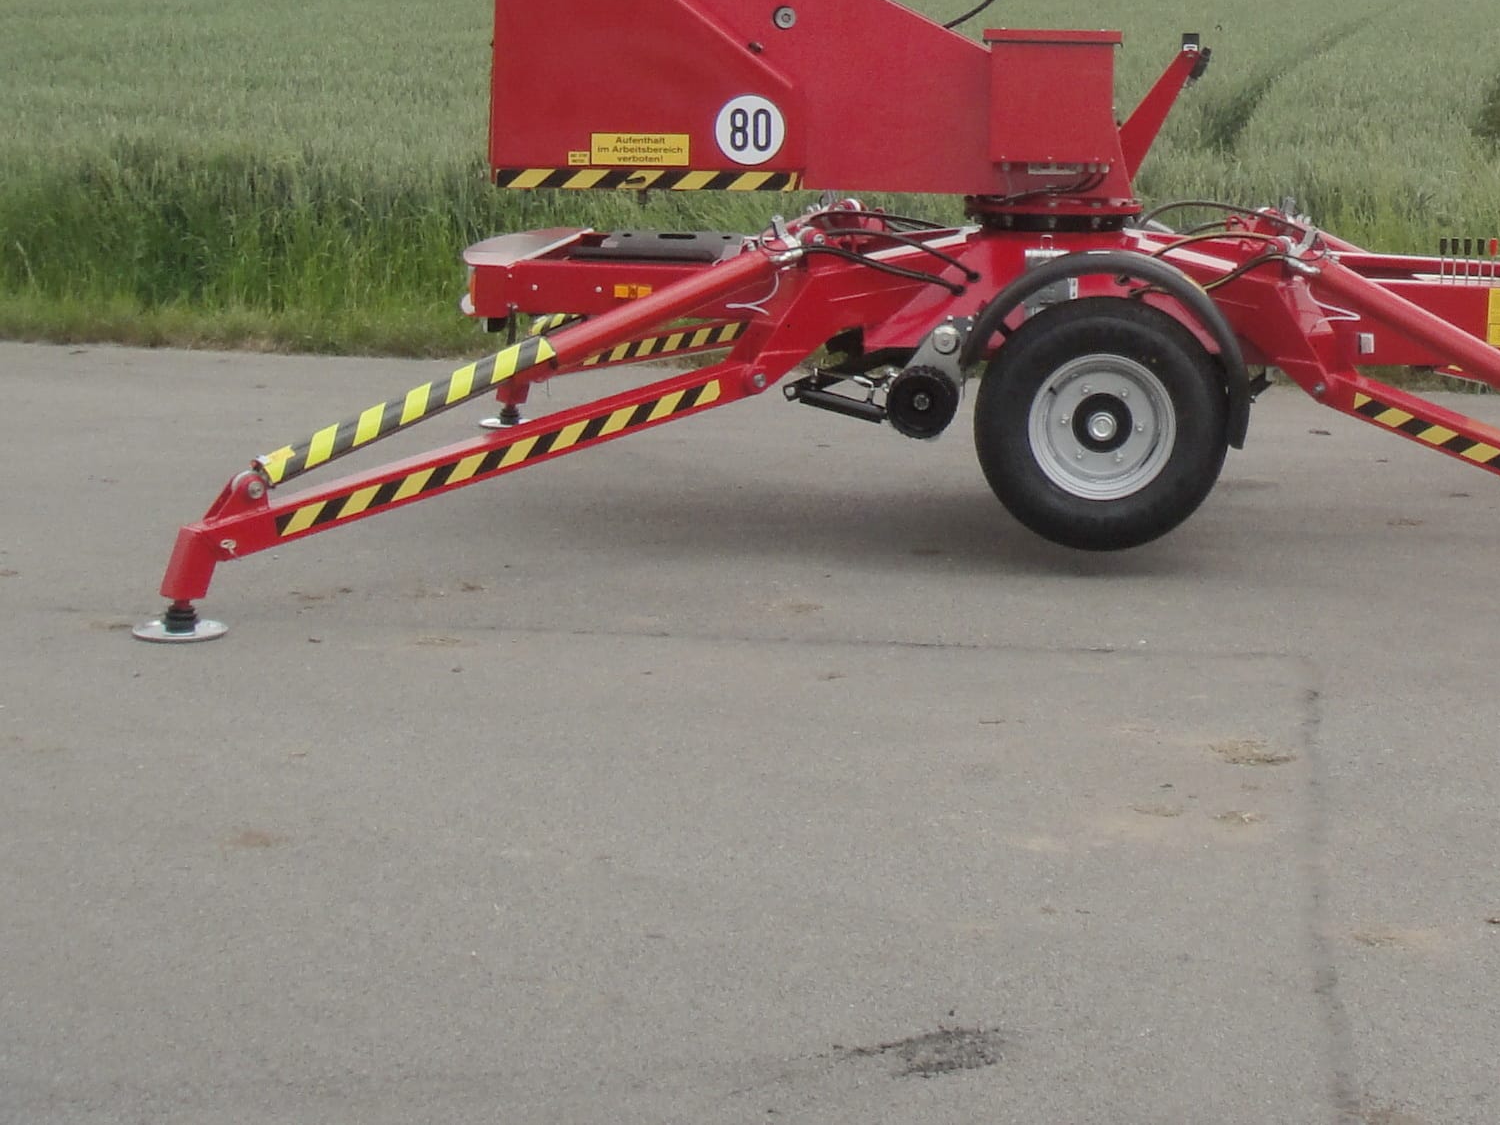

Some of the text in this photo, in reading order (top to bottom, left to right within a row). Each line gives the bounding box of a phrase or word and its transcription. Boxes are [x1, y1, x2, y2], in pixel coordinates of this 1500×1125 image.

[730, 108, 772, 152] 80
[615, 136, 665, 145] Aufenthalt
[597, 145, 684, 154] im Arbeitsbereich
[616, 154, 664, 163] verboten!
